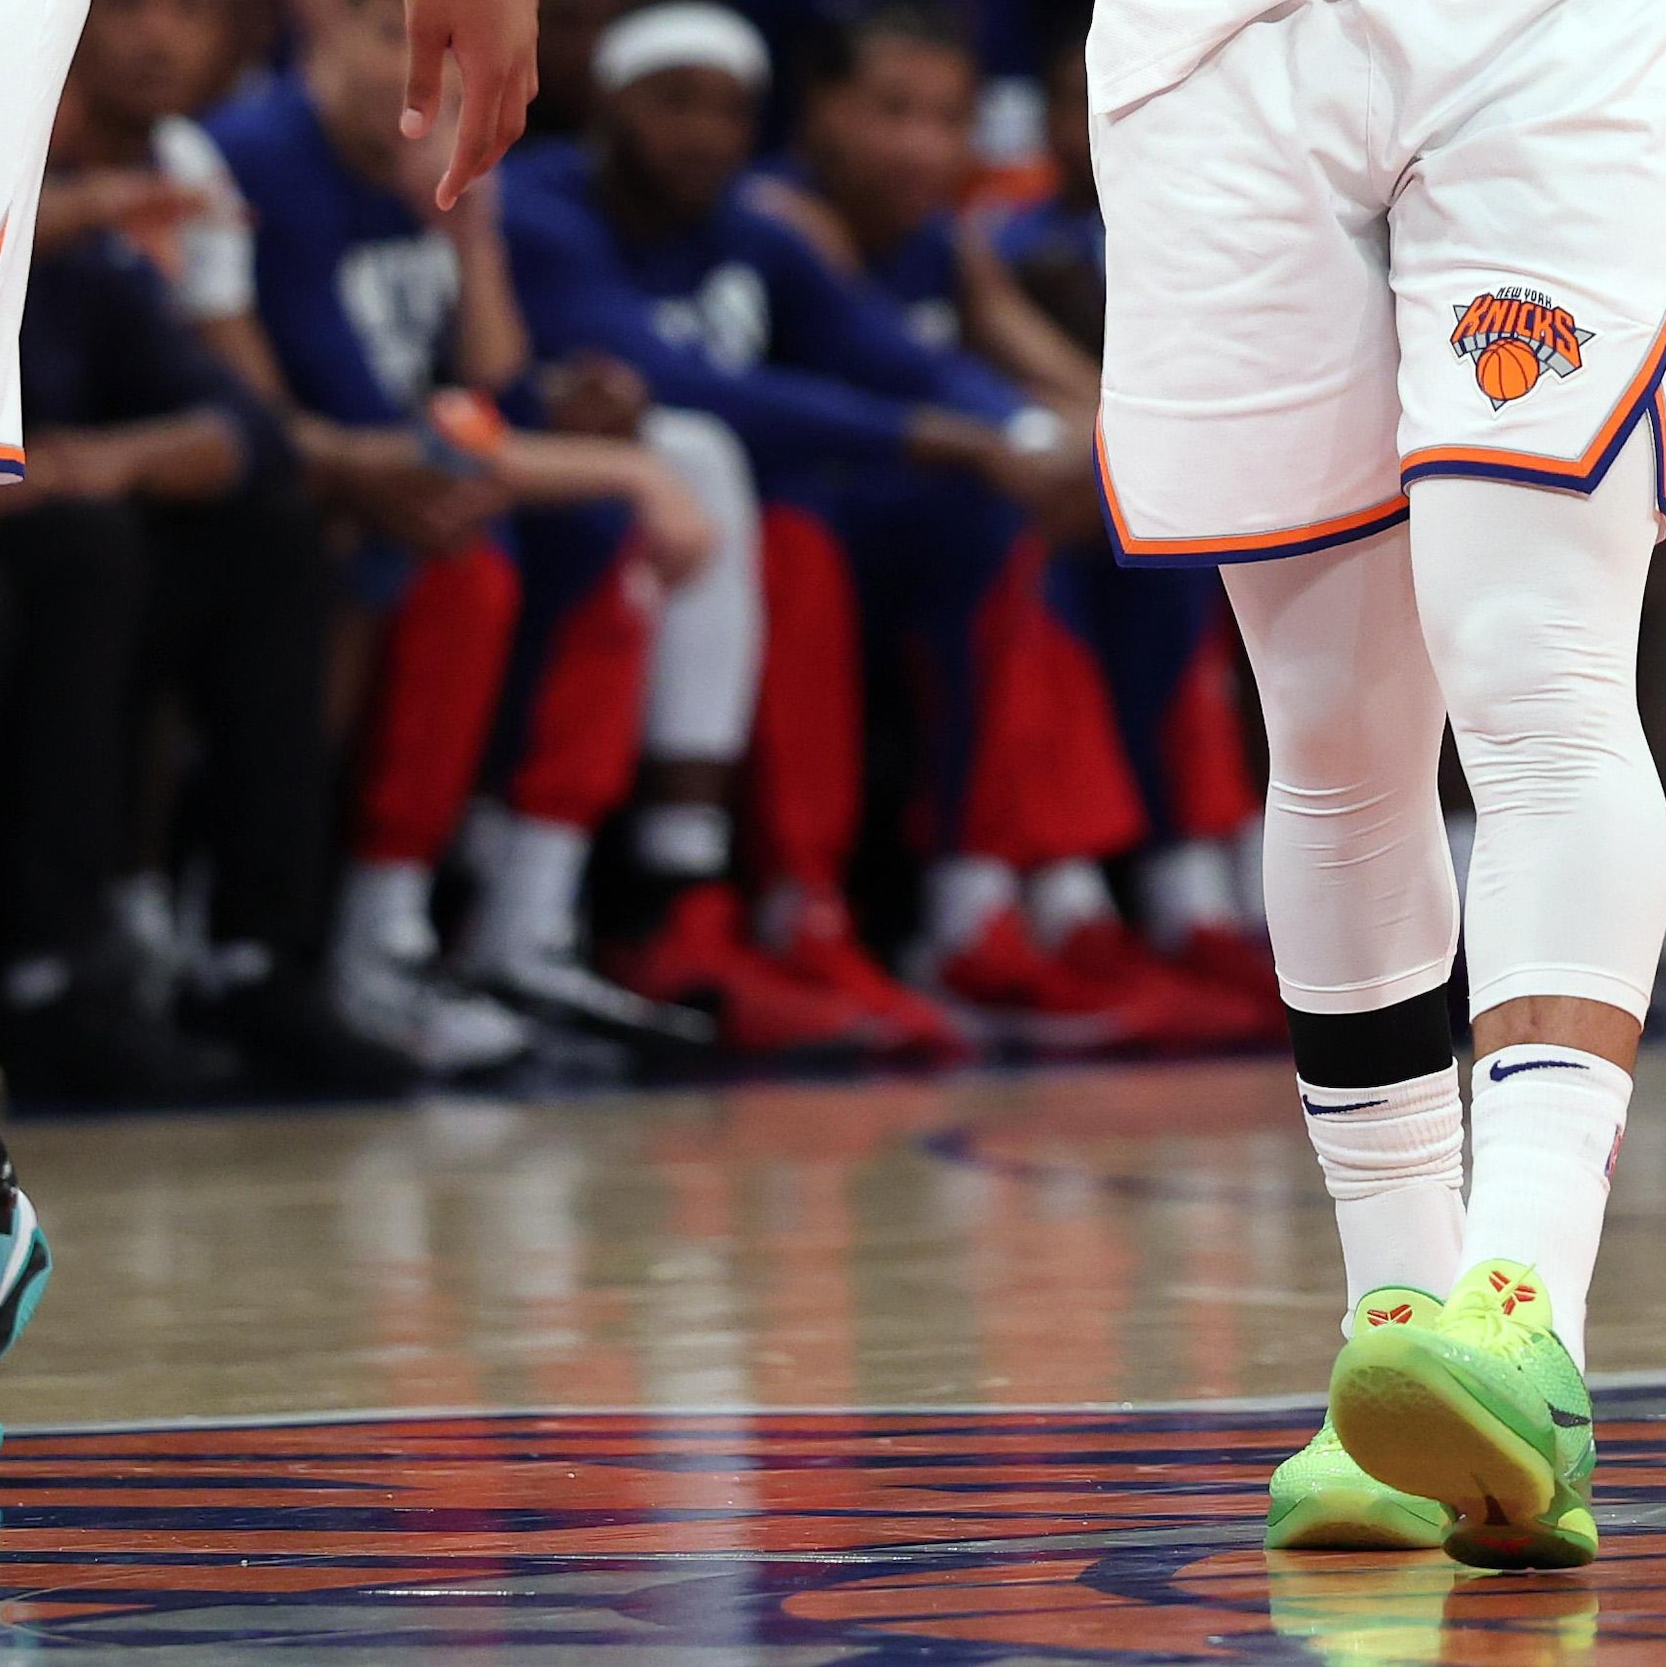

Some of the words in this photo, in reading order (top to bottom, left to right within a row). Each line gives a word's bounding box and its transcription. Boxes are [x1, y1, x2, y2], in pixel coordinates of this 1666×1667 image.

[1496, 286, 1523, 299] NEW
[1524, 288, 1552, 307] YORK
[1450, 292, 1583, 370] KNICKS
